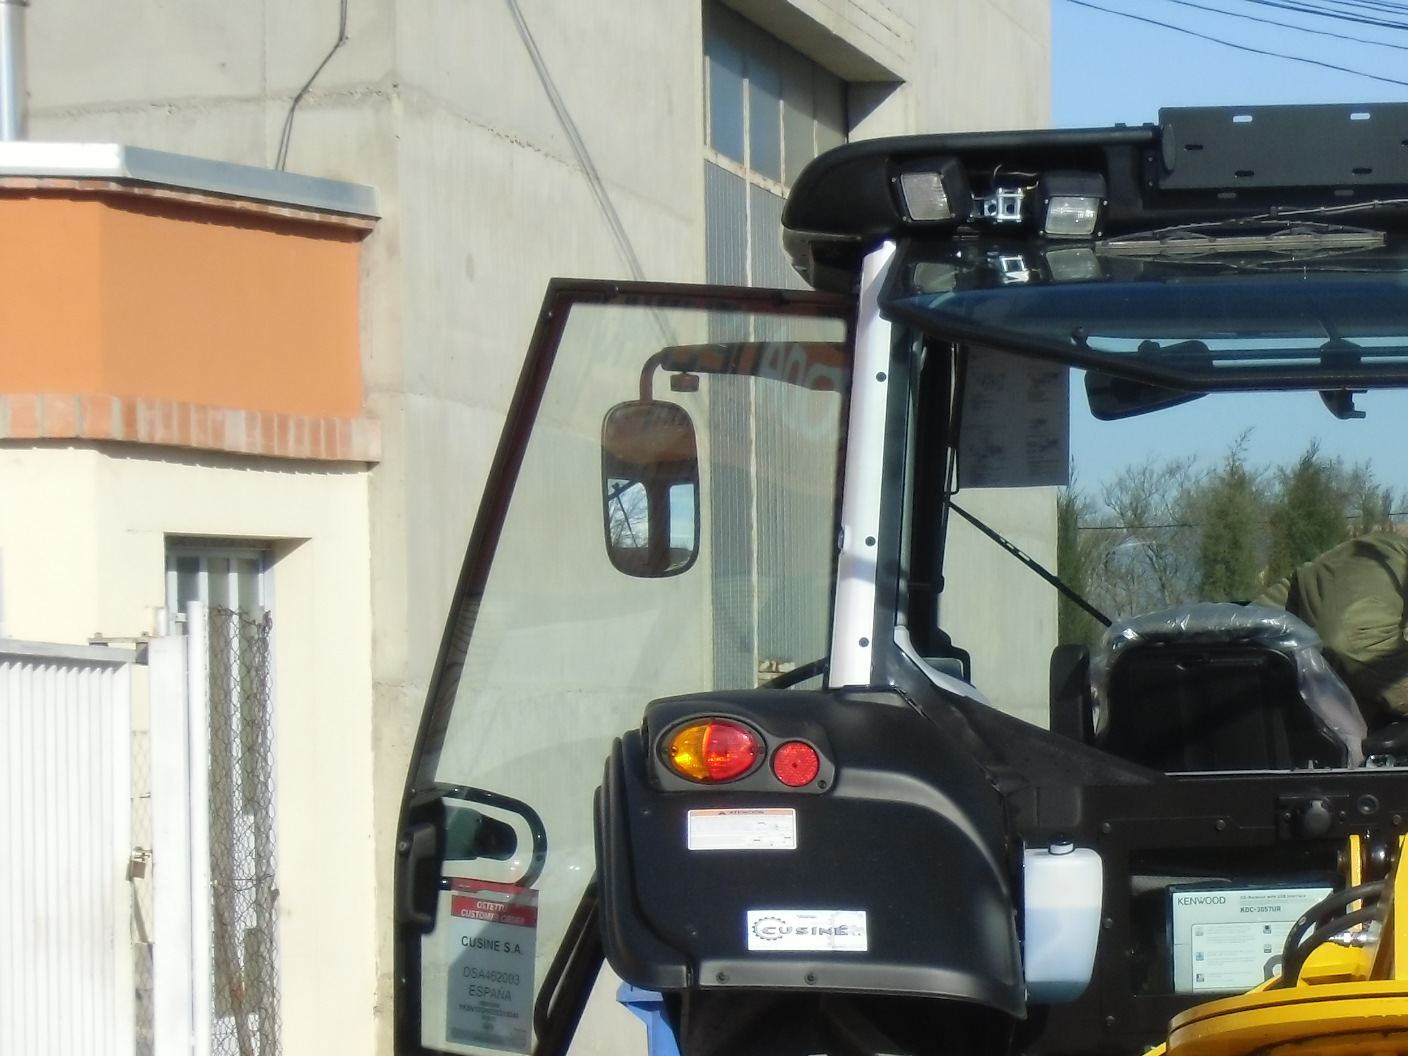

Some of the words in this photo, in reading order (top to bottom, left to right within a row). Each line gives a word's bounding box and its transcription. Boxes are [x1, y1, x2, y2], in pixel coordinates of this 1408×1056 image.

[1177, 896, 1226, 906] KENWOOD
[461, 935, 500, 952] CUSINE
[503, 942, 524, 955] S.A.
[463, 966, 520, 986] DSA462003
[468, 984, 512, 1002] ESPAÑA
